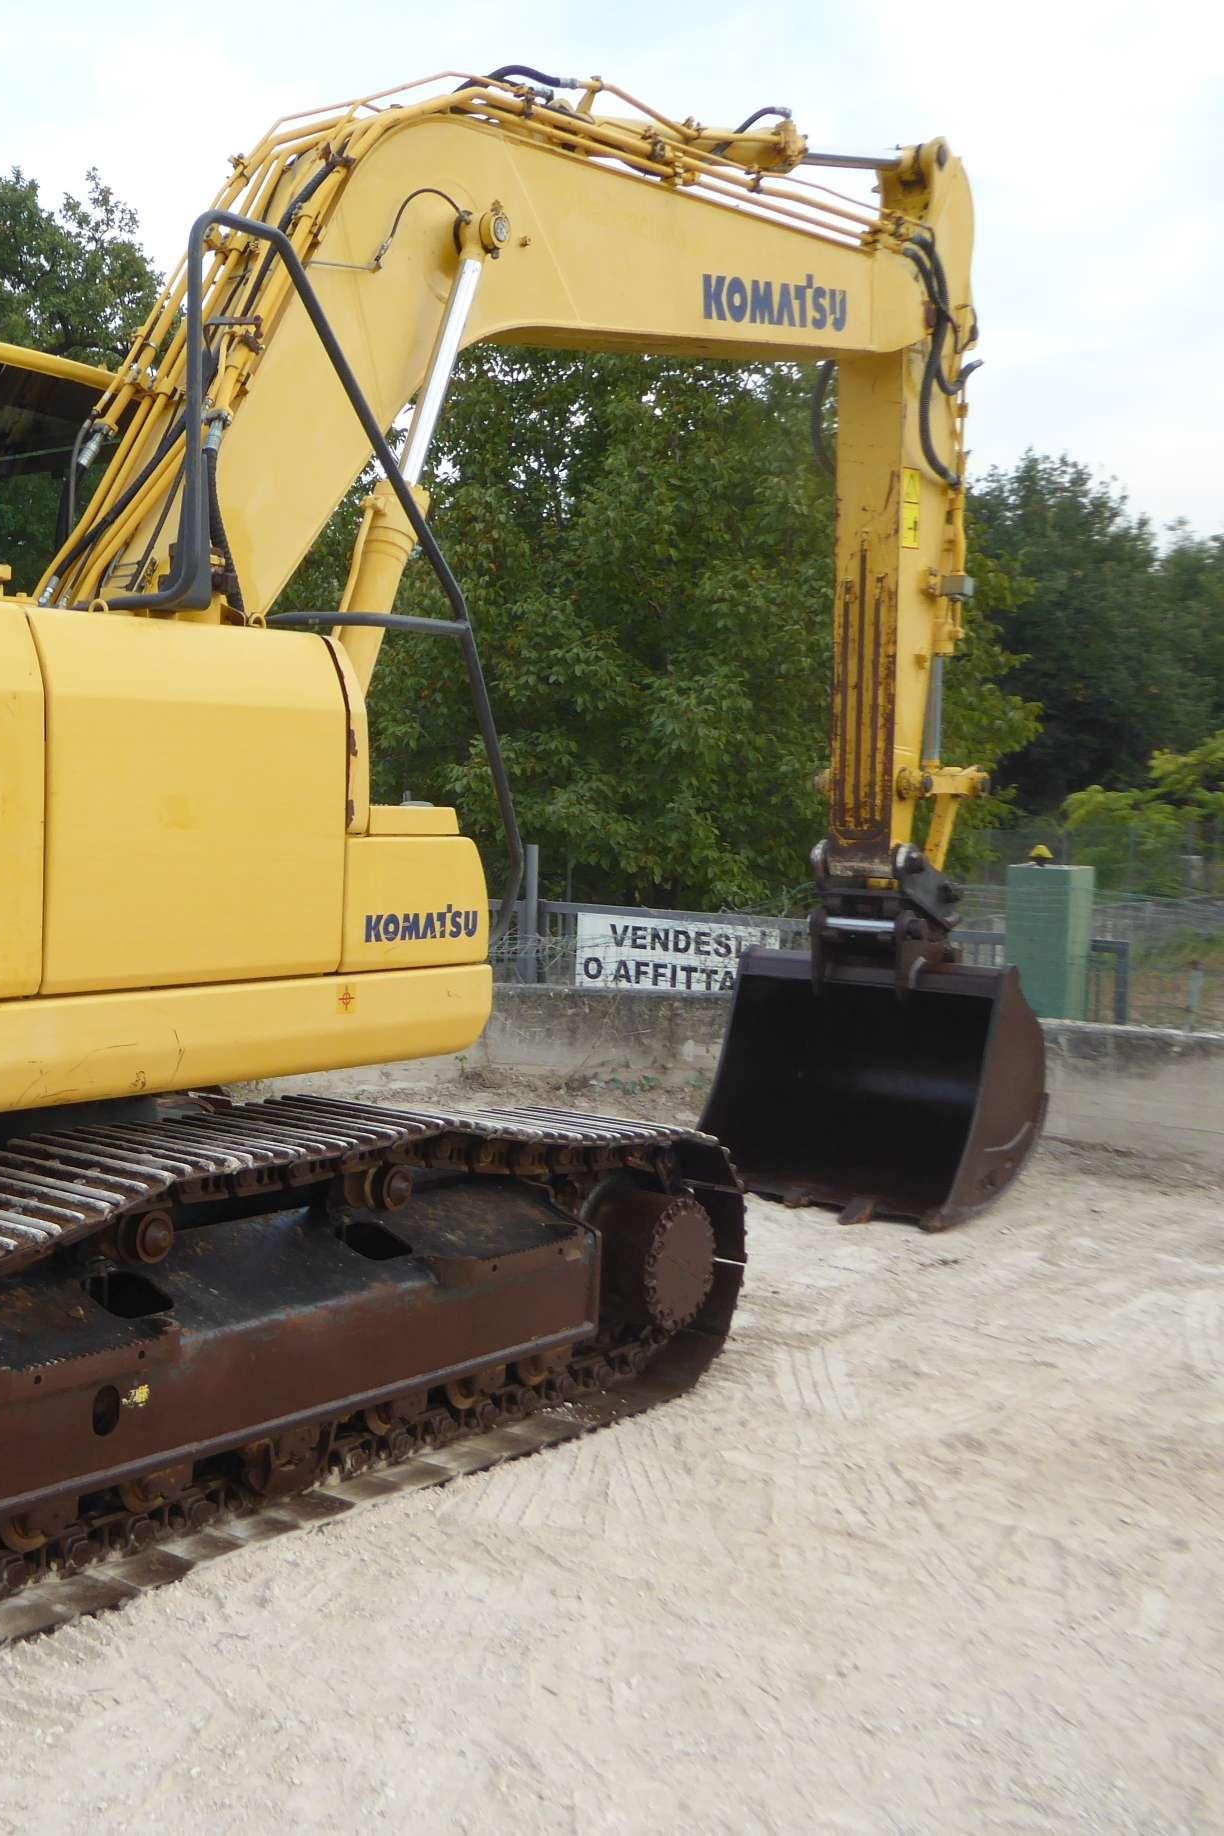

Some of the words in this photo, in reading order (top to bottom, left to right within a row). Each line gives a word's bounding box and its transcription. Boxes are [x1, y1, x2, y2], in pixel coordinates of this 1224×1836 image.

[702, 273, 848, 333] KOMATSU
[364, 903, 479, 943] KOMATSU
[609, 923, 742, 959] VENDESI
[583, 956, 604, 980] O
